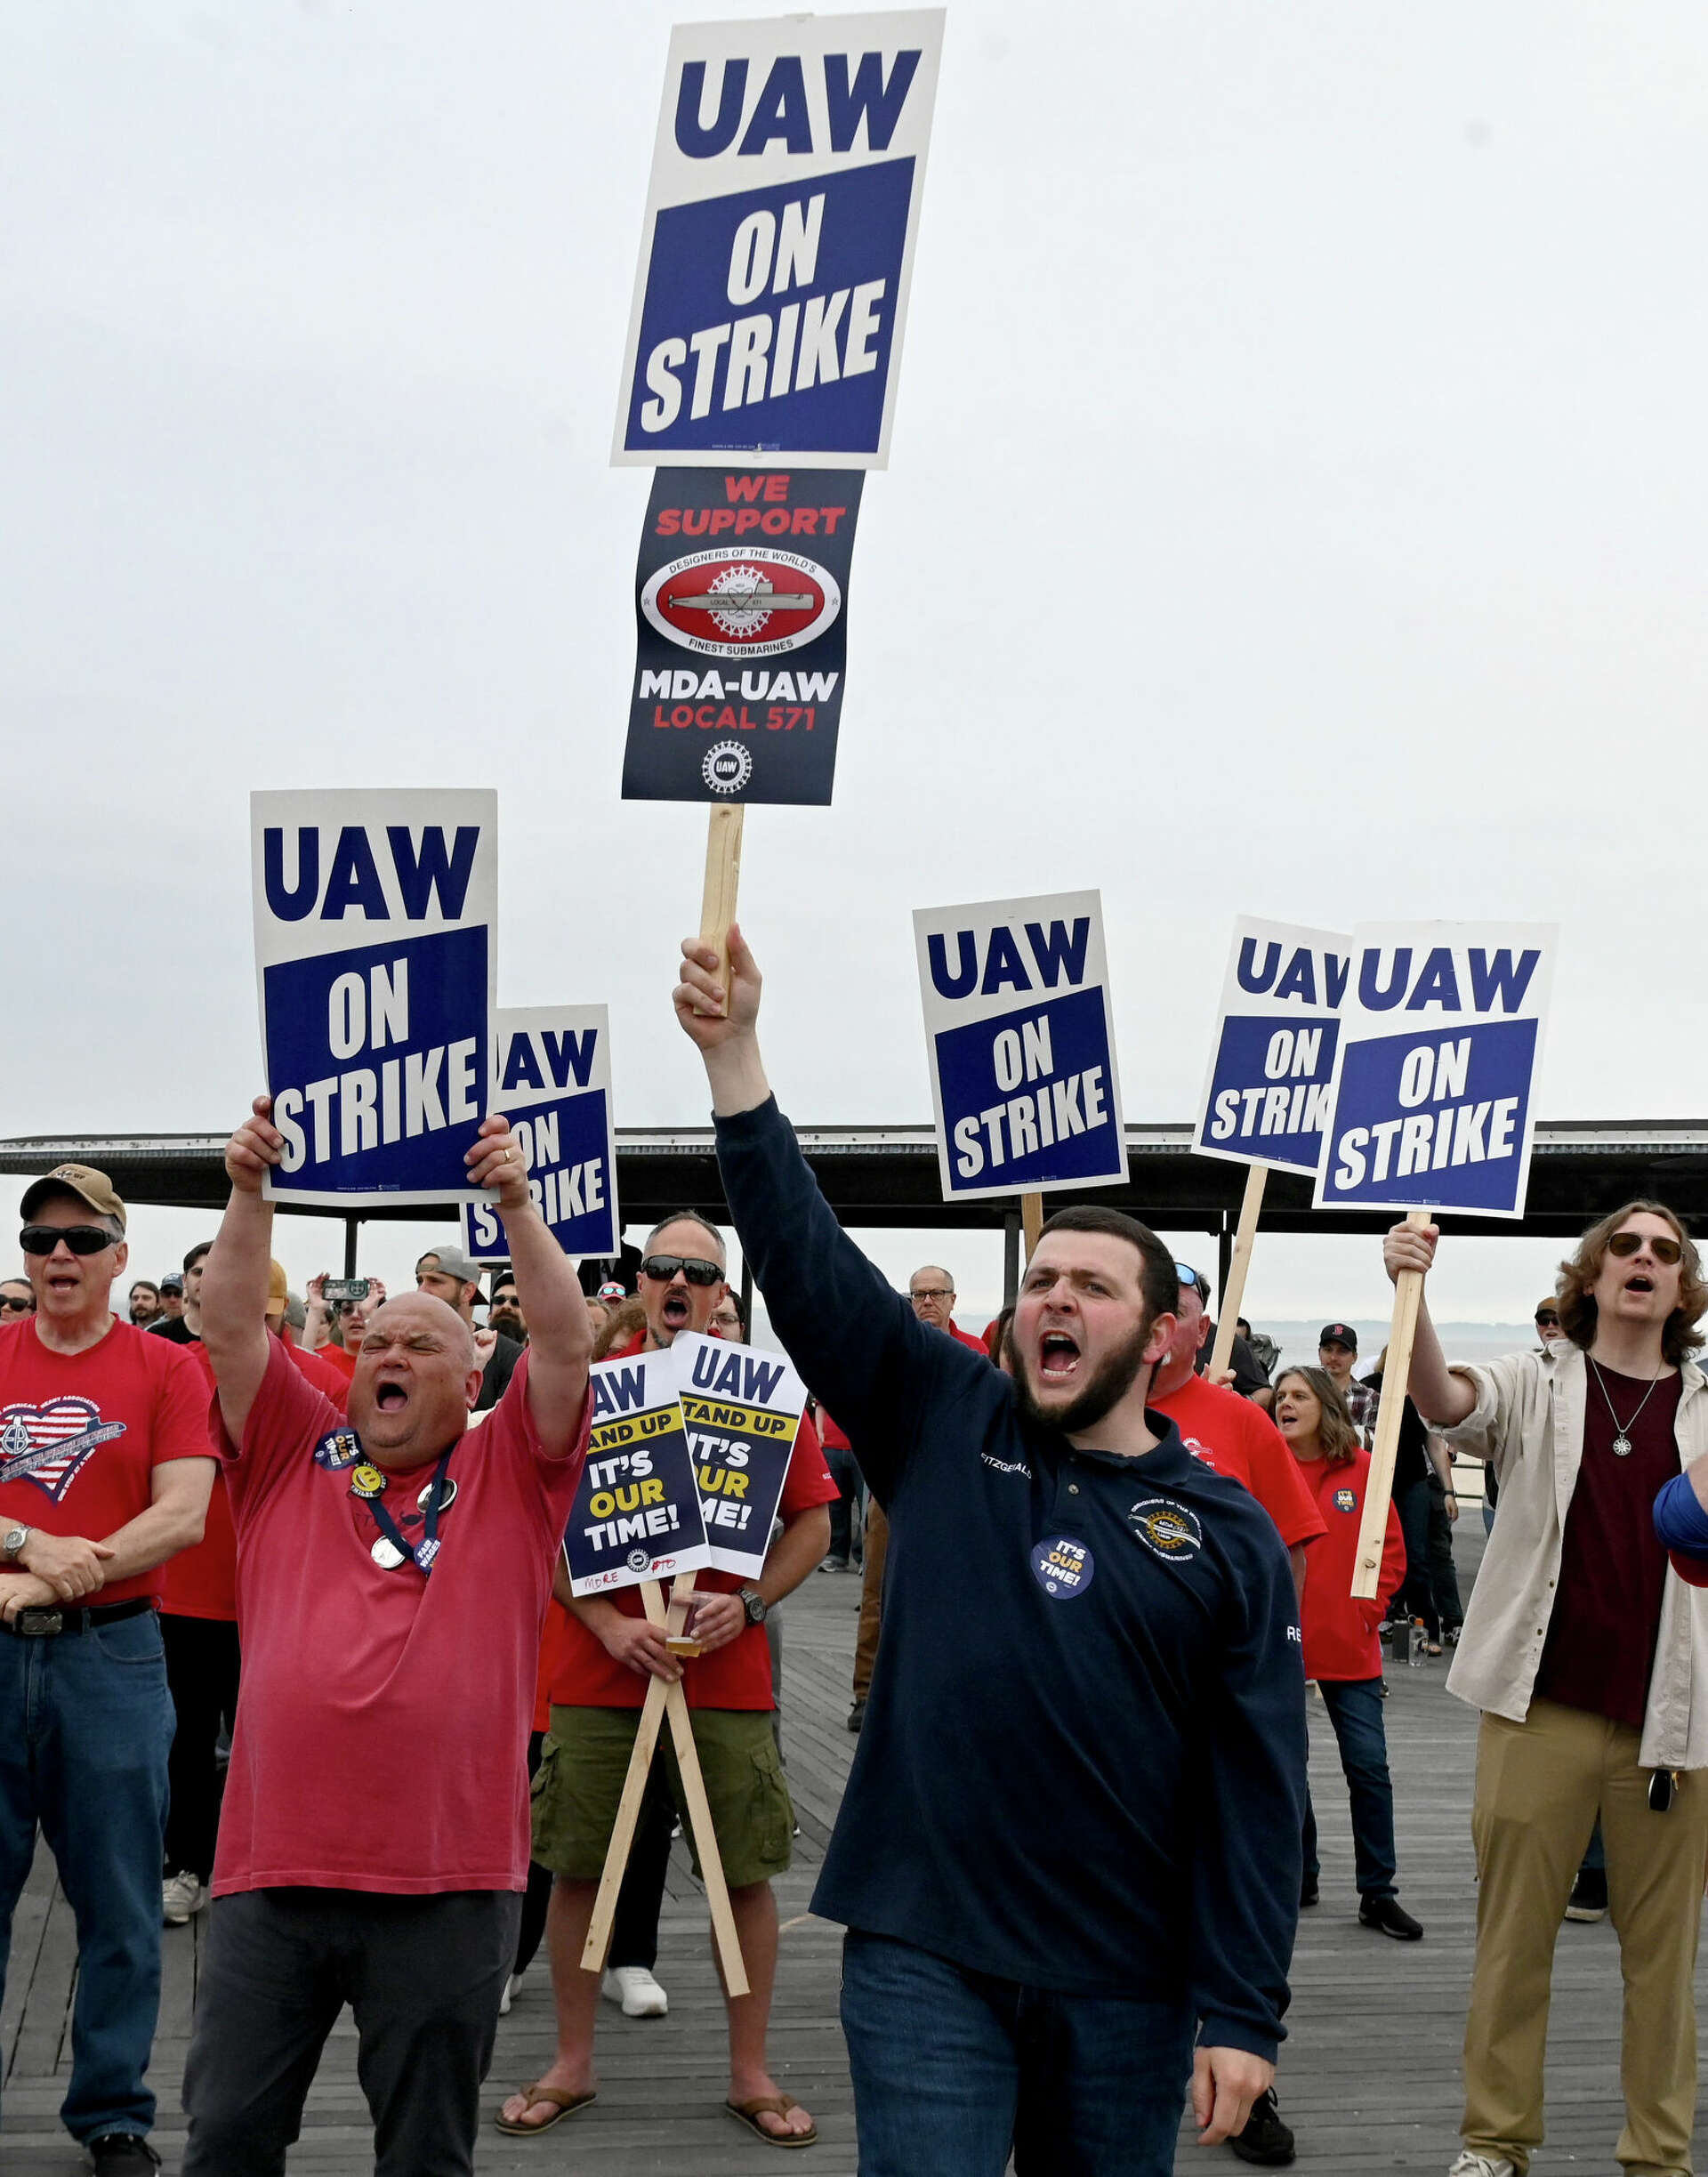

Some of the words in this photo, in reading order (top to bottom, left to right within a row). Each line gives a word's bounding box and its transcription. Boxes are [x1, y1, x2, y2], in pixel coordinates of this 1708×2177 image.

[674, 49, 922, 159] UAW
[727, 193, 826, 306] ON
[640, 278, 886, 433] STRIKE
[724, 475, 790, 503] WE
[656, 506, 846, 536] SUPPORT
[669, 551, 729, 574] DESIGNERS
[732, 549, 746, 557] OF
[750, 549, 769, 559] THE
[772, 552, 818, 574] WORLD'S
[689, 638, 723, 654] FINEST
[727, 640, 794, 656] SUBMARINES
[640, 670, 839, 702] MDA-UAW
[654, 706, 756, 730] LOCAL
[766, 707, 815, 730] 571
[716, 761, 737, 774] UAW
[263, 826, 480, 922] UAW
[927, 916, 1091, 999] UAW
[1358, 947, 1542, 1013] UAW
[328, 957, 409, 1060] ON
[496, 1028, 598, 1091] AW
[993, 1014, 1054, 1093] ON
[1263, 1028, 1323, 1080] ON
[1398, 1036, 1471, 1109] ON
[273, 1036, 478, 1173] STRIKE
[954, 1065, 1108, 1179] STRIKE
[1210, 1083, 1331, 1140] STRIK
[510, 1110, 560, 1173] ON
[1334, 1096, 1519, 1191] STRIKE
[590, 1364, 646, 1417] AW
[692, 1345, 785, 1404] UAW
[589, 1424, 633, 1449] AND
[640, 1414, 672, 1434] UP
[683, 1400, 746, 1427] TAND
[753, 1415, 786, 1435] UP
[325, 1438, 342, 1466] TIME!
[335, 1435, 350, 1460] OUR
[345, 1434, 359, 1456] IT'S
[589, 1450, 653, 1489] IT'S
[693, 1466, 750, 1499] UR
[589, 1478, 665, 1518] OUR
[584, 1504, 680, 1552] TIME!
[417, 1539, 432, 1559] FAIR
[420, 1539, 441, 1568] WAGES
[1049, 1552, 1083, 1573] OUR
[1056, 1540, 1086, 1560] IT'S
[584, 1572, 618, 1590] MORE
[1040, 1560, 1081, 1586] TIME!
